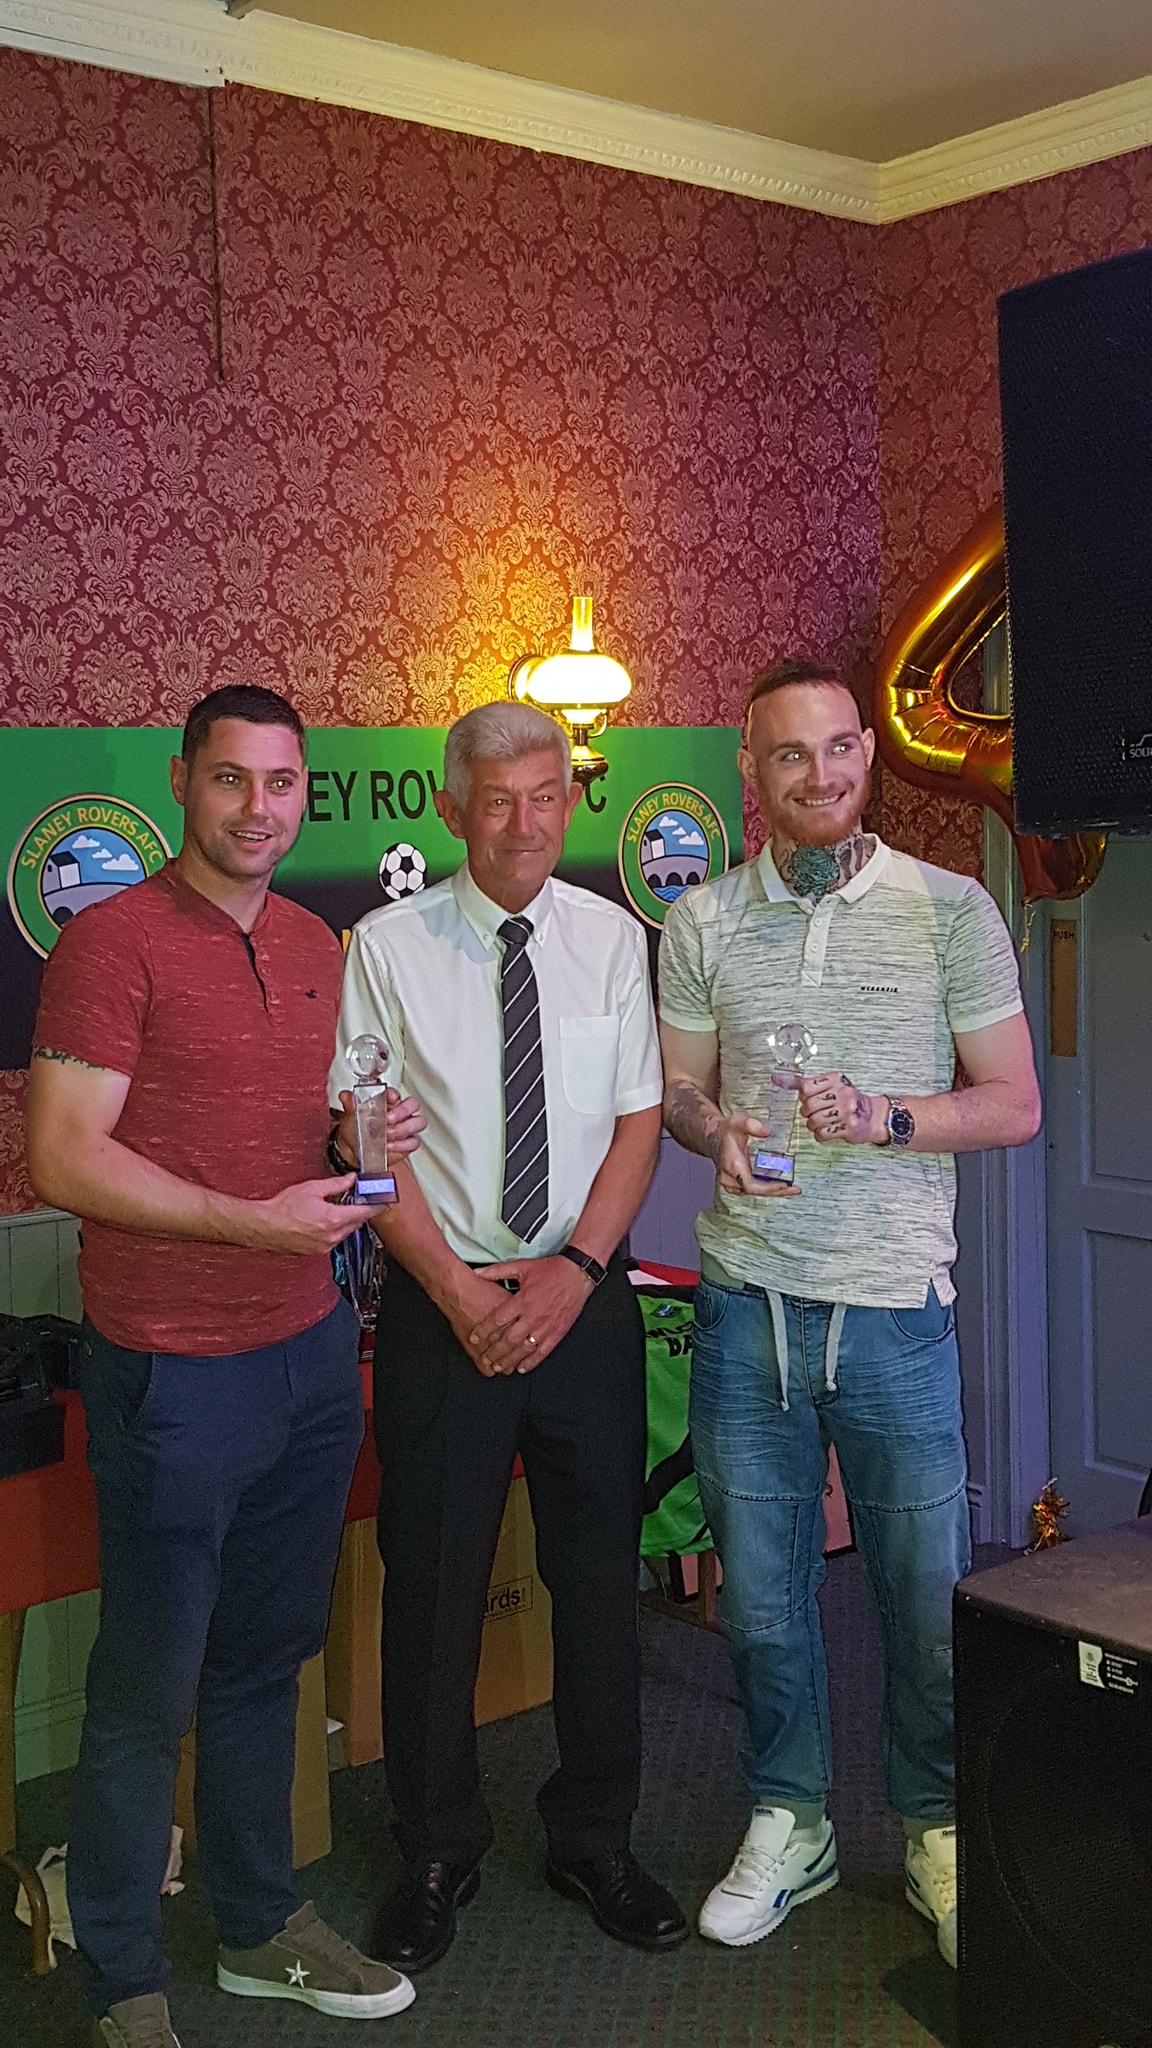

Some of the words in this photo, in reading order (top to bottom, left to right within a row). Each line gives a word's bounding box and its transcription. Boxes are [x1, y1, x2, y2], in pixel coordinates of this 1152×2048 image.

[300, 771, 358, 821] EY
[627, 796, 659, 843] SLANEY
[662, 792, 705, 817] ROVERS
[703, 812, 721, 840] AFC
[21, 811, 72, 868] SLANEY
[77, 806, 139, 836] ROVERS
[136, 832, 163, 864] AFC
[1053, 930, 1075, 940] PUSH
